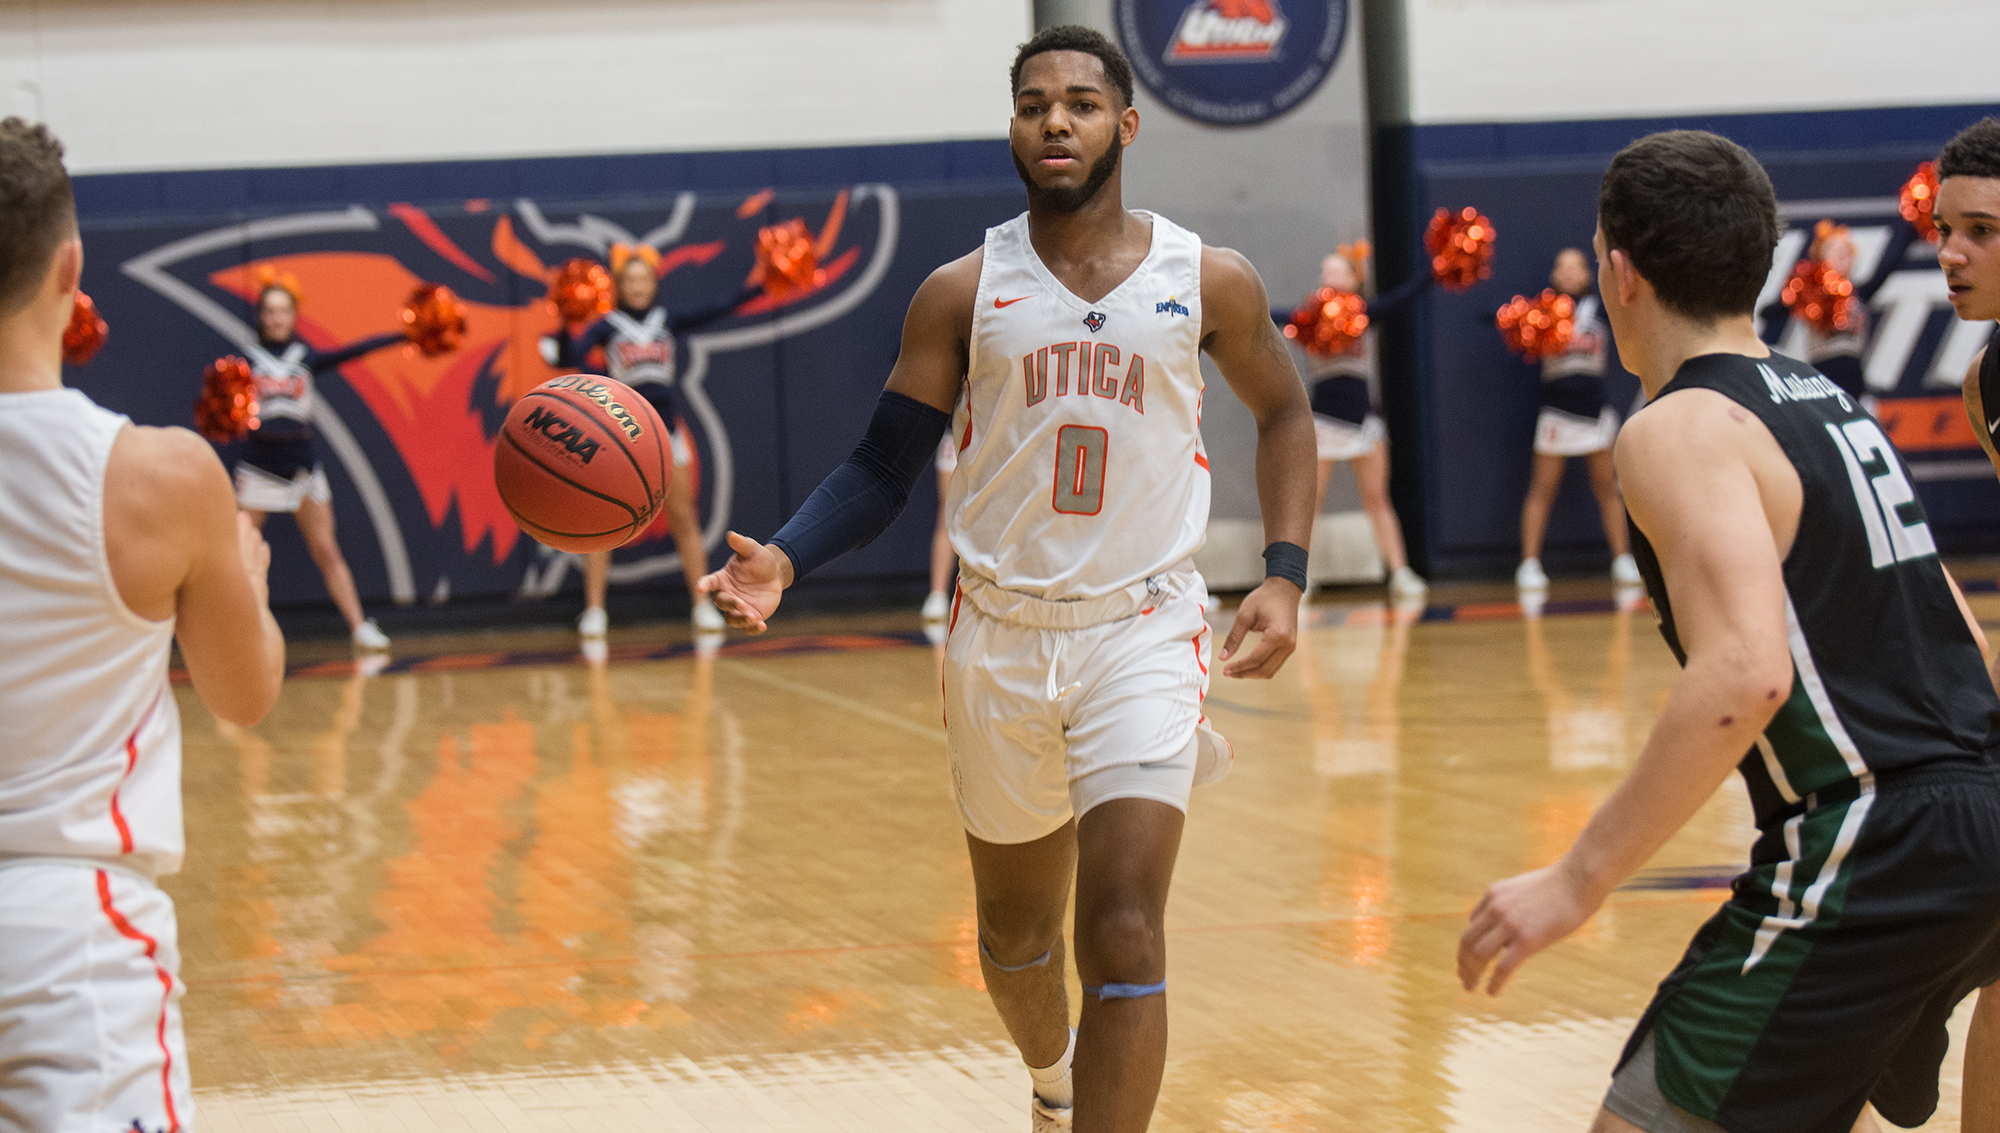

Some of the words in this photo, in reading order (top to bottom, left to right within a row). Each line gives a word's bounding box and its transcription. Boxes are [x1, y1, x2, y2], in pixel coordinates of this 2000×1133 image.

[545, 375, 643, 443] Wilson
[1023, 341, 1145, 416] UTICA
[523, 405, 600, 465] NCAA
[1052, 424, 1109, 516] 0
[1824, 417, 1938, 570] 12
